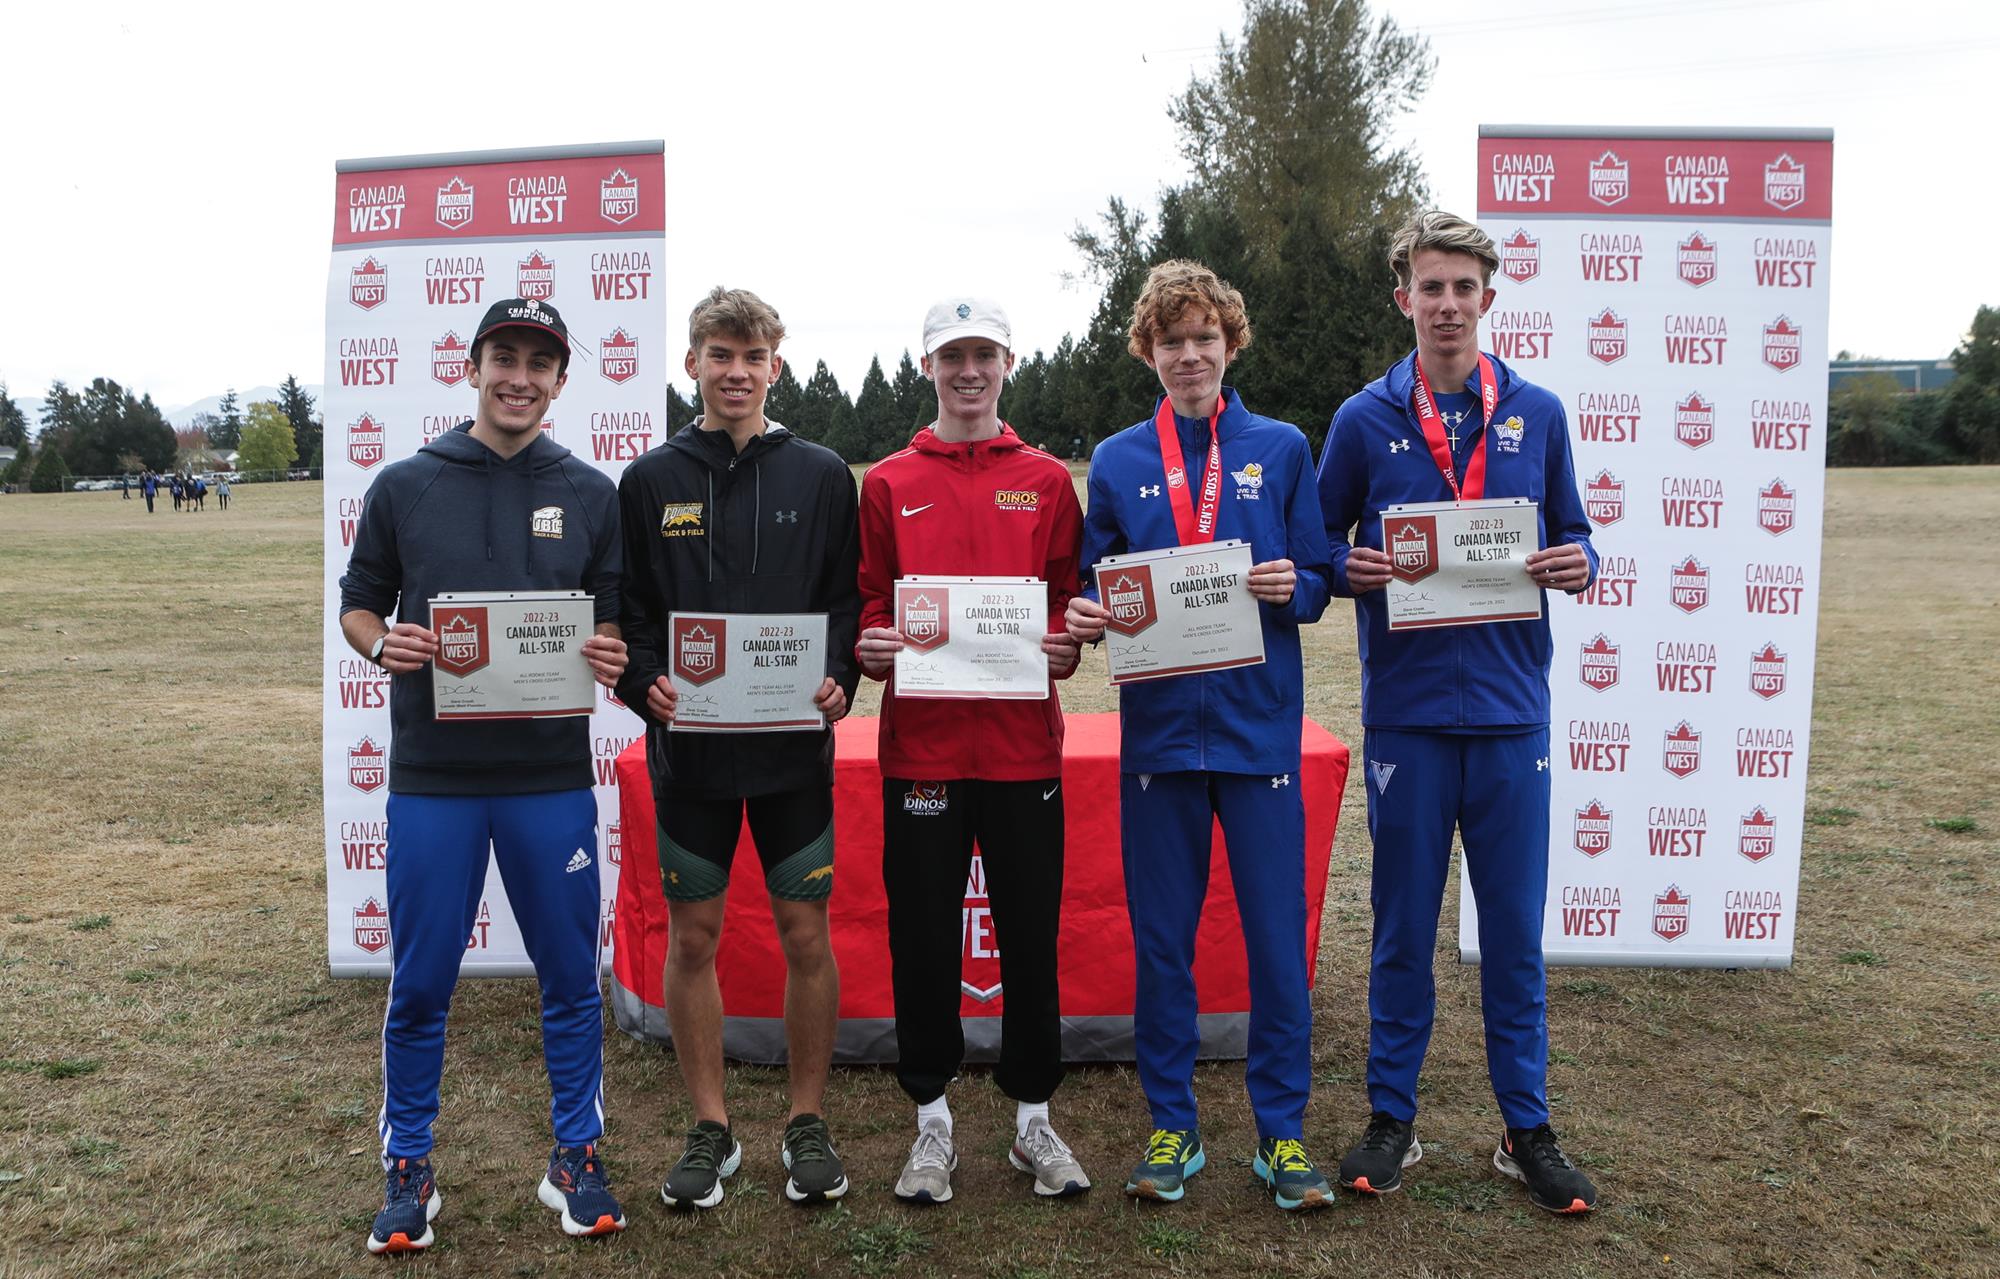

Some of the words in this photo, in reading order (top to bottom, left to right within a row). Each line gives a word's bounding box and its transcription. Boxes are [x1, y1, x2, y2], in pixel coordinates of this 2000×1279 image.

[1493, 154, 1554, 173] CANADA
[1666, 156, 1728, 176] CANADA
[508, 176, 567, 196] CANADA
[1493, 175, 1555, 202] WEST
[1594, 182, 1624, 196] WEST
[1666, 177, 1728, 204] WEST
[1768, 186, 1800, 200] WEST
[350, 186, 406, 206] CANADA
[440, 195, 470, 204] CANADA
[605, 189, 634, 198] CANADA
[440, 206, 469, 221] WEST
[508, 196, 567, 224] WEST
[604, 201, 634, 214] WEST
[350, 204, 405, 232] WEST
[1581, 234, 1642, 253] CANADA
[1755, 238, 1816, 258] CANADA
[1505, 249, 1536, 258] CANADA
[426, 257, 484, 276] CANADA
[592, 252, 650, 271] CANADA
[1506, 261, 1536, 275] WEST
[1582, 255, 1642, 282] WEST
[521, 270, 551, 280] CANADA
[1682, 265, 1713, 278] WEST
[1755, 260, 1816, 288] WEST
[354, 275, 384, 285] CANADA
[592, 273, 651, 301] WEST
[354, 288, 383, 301] WEST
[426, 277, 484, 305] WEST
[521, 283, 550, 297] WEST
[508, 308, 553, 323] CHAMPIONS
[1491, 311, 1553, 330] CANADA
[1665, 315, 1727, 335] CANADA
[1592, 329, 1623, 338] CANADA
[341, 338, 398, 357] CANADA
[604, 349, 634, 357] CANADA
[1492, 333, 1553, 359] WEST
[1593, 341, 1623, 355] WEST
[1666, 337, 1727, 365] WEST
[436, 352, 465, 360] CANADA
[1767, 349, 1798, 363] WEST
[341, 359, 398, 386] WEST
[436, 364, 464, 377] WEST
[604, 361, 635, 374] WEST
[1579, 393, 1640, 413] CANADA
[1752, 400, 1811, 422] CANADA
[591, 412, 651, 431] CANADA
[1579, 414, 1641, 442] WEST
[352, 434, 381, 442] CANADA
[1679, 426, 1711, 440] WEST
[1752, 422, 1811, 451] WEST
[352, 446, 381, 459] WEST
[592, 434, 652, 461] WEST
[1204, 472, 1218, 501] CROSS
[1662, 477, 1723, 498] CANADA
[997, 492, 1038, 505] DINOS
[1588, 503, 1621, 518] WEST
[1663, 499, 1723, 528] WEST
[1198, 503, 1213, 534] MEN'S
[1470, 519, 1503, 530] 2022-23
[1761, 512, 1791, 527] WEST
[533, 519, 562, 533] UBC
[1455, 533, 1491, 546] CANADA
[1494, 531, 1521, 544] WEST
[1396, 542, 1424, 550] CANADA
[1397, 553, 1424, 566] WEST
[1467, 548, 1510, 561] ALL-STAR
[1185, 563, 1219, 577] 2022-23
[1746, 564, 1803, 585] CANADA
[1170, 578, 1209, 595] CANADA
[1211, 574, 1238, 588] WEST
[1675, 577, 1705, 587] CANADA
[982, 595, 1014, 604] 2022-23
[1112, 593, 1141, 602] CANADA
[1184, 592, 1229, 609] ALL-STAR
[1673, 590, 1705, 604] WEST
[1746, 585, 1803, 614] WEST
[524, 612, 559, 622] 2022-23
[909, 611, 936, 619] CANADA
[966, 608, 1002, 619] CANADA
[1005, 609, 1030, 619] WEST
[1114, 605, 1142, 618] WEST
[507, 626, 546, 638] CANADA
[549, 625, 576, 637] WEST
[760, 627, 793, 636] 2022-23
[909, 622, 936, 634] WEST
[977, 623, 1019, 635] ALL-STAR
[445, 634, 474, 642] CANADA
[446, 645, 474, 658] WEST
[519, 641, 565, 654] ALL-STAR
[684, 642, 712, 651] CANADA
[743, 640, 781, 652] CANADA
[783, 640, 809, 651] WEST
[1657, 642, 1716, 663] CANADA
[685, 654, 712, 666] WEST
[754, 655, 797, 667] ALL-STAR
[1584, 654, 1616, 664] CANADA
[1584, 668, 1616, 682] WEST
[1657, 664, 1716, 693] WEST
[1754, 676, 1783, 690] WEST
[1570, 721, 1630, 741] CANADA
[1737, 728, 1793, 748] CANADA
[352, 757, 382, 766] CANADA
[1570, 742, 1630, 772] WEST
[1668, 755, 1697, 768] WEST
[1737, 750, 1793, 778] WEST
[352, 770, 382, 783] WEST
[906, 798, 946, 809] DINOS
[1649, 807, 1707, 827] CANADA
[1579, 821, 1608, 830] CANADA
[1579, 833, 1608, 848] WEST
[1649, 829, 1706, 857] WEST
[1743, 839, 1771, 853] WEST
[342, 843, 386, 870] WES
[1563, 887, 1621, 906] CANADA
[1726, 891, 1782, 910] CANADA
[357, 918, 386, 926] CANADA
[1563, 908, 1621, 936] WEST
[1656, 918, 1686, 931] WEST
[1725, 912, 1781, 939] WEST
[358, 930, 386, 944] WEST
